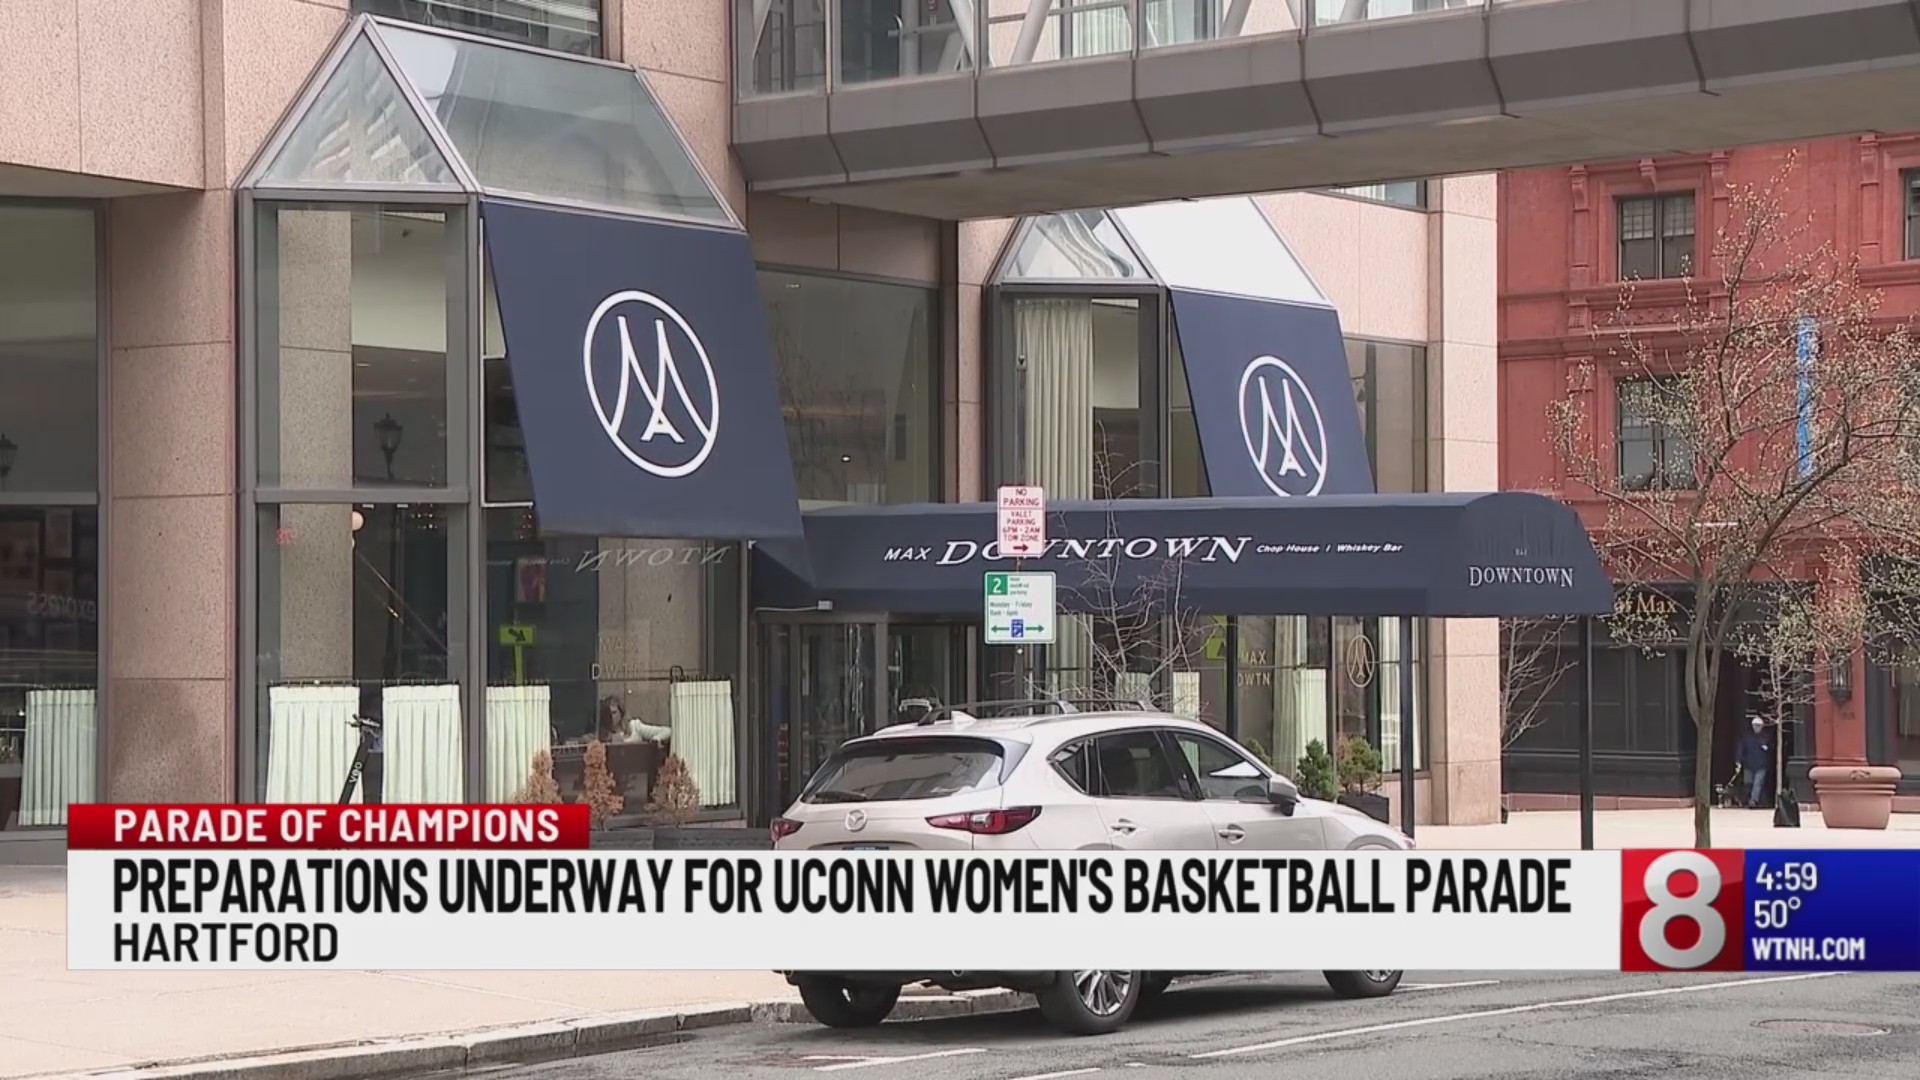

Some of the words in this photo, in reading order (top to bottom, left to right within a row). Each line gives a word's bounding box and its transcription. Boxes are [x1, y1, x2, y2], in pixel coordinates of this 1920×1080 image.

[1003, 498, 1040, 506] PARKING
[884, 547, 931, 562] MAX
[936, 536, 1252, 565] DONTOWN
[1256, 545, 1284, 553] Chop
[1285, 544, 1320, 553] House
[1337, 544, 1381, 553] Whiskey
[1382, 543, 1403, 552] Bar
[992, 577, 1001, 594] 2
[1469, 566, 1574, 588] DOWNTOWN
[1636, 592, 1677, 614] Max
[1237, 671, 1270, 687] DWTN
